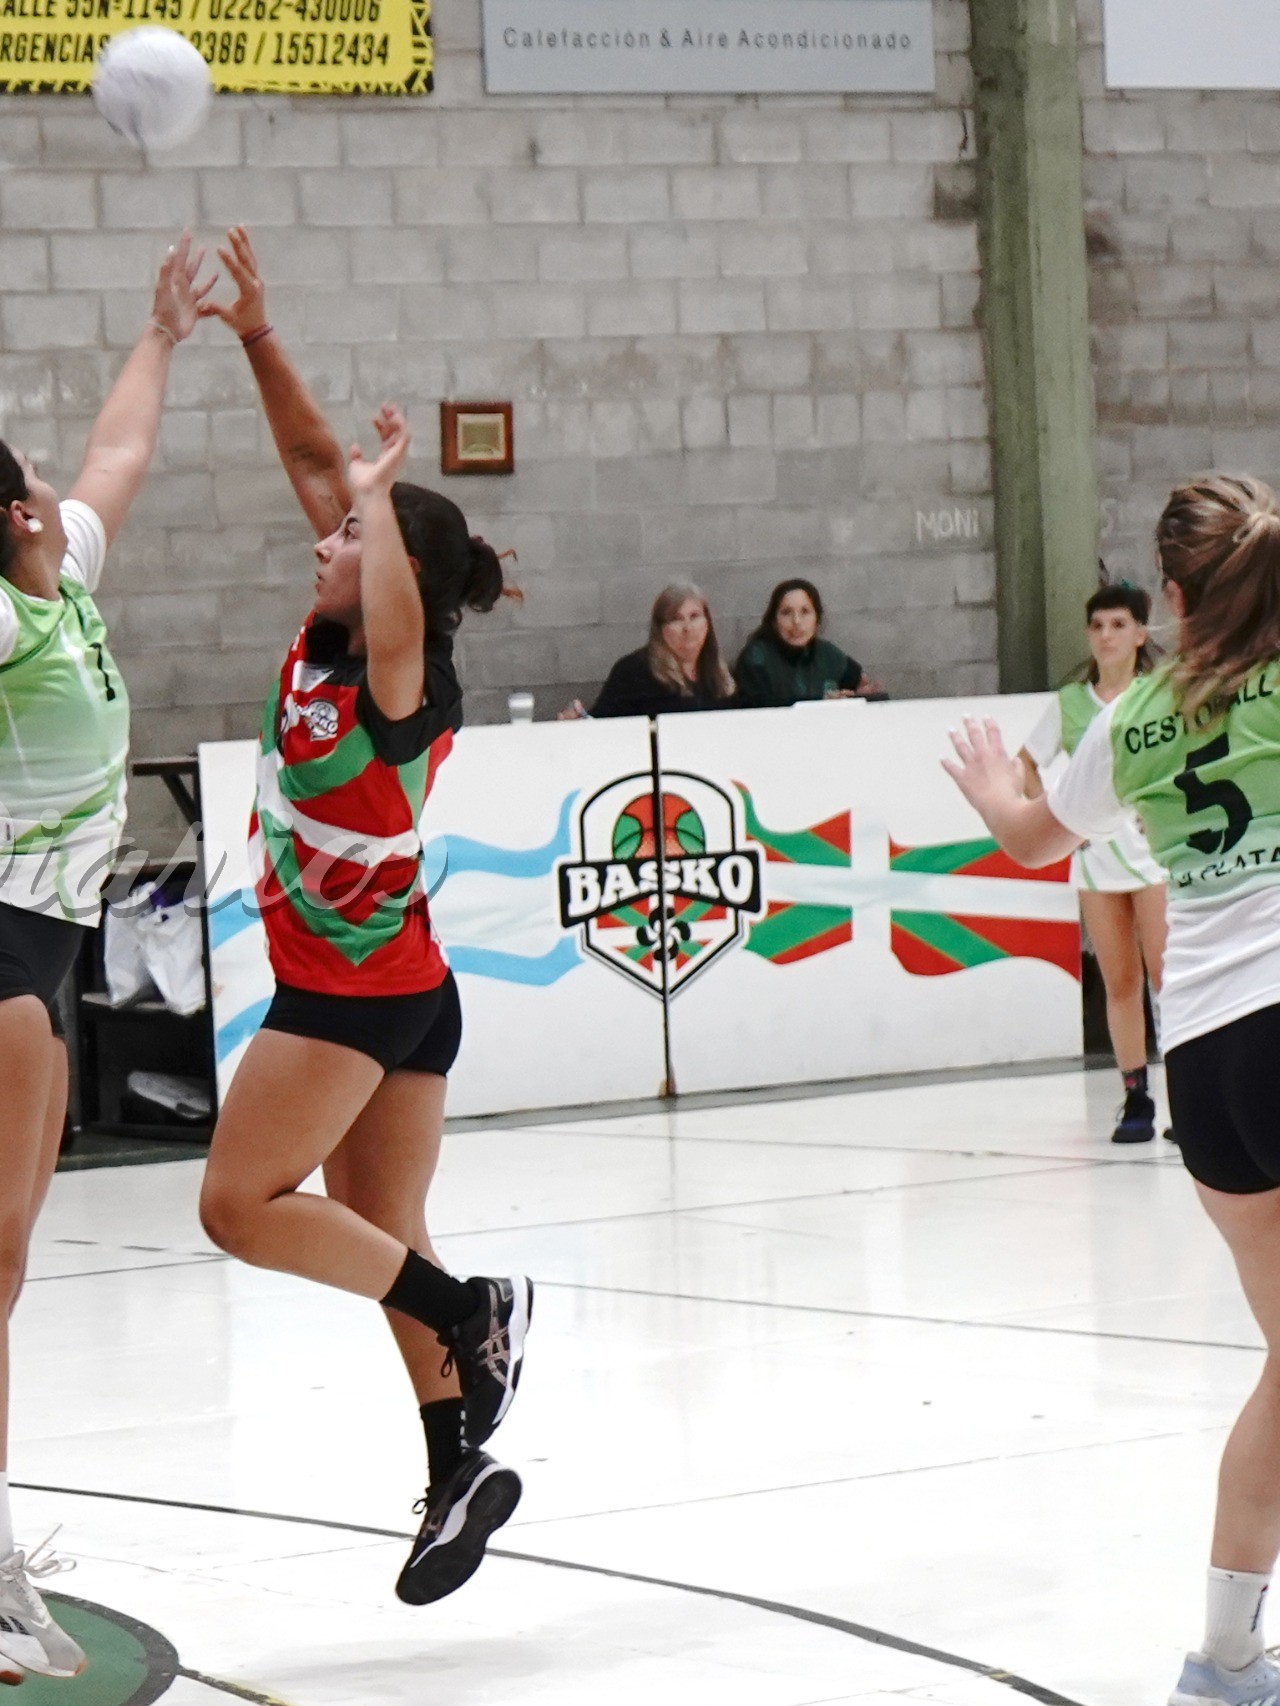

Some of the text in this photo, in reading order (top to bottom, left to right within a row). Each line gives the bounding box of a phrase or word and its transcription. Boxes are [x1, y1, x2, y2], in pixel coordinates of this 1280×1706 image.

[272, 32, 389, 66] 15512434
[681, 28, 728, 48] Aire
[737, 28, 912, 50] Acondicionado
[1173, 732, 1253, 855] 5
[566, 854, 753, 917] BASKO
